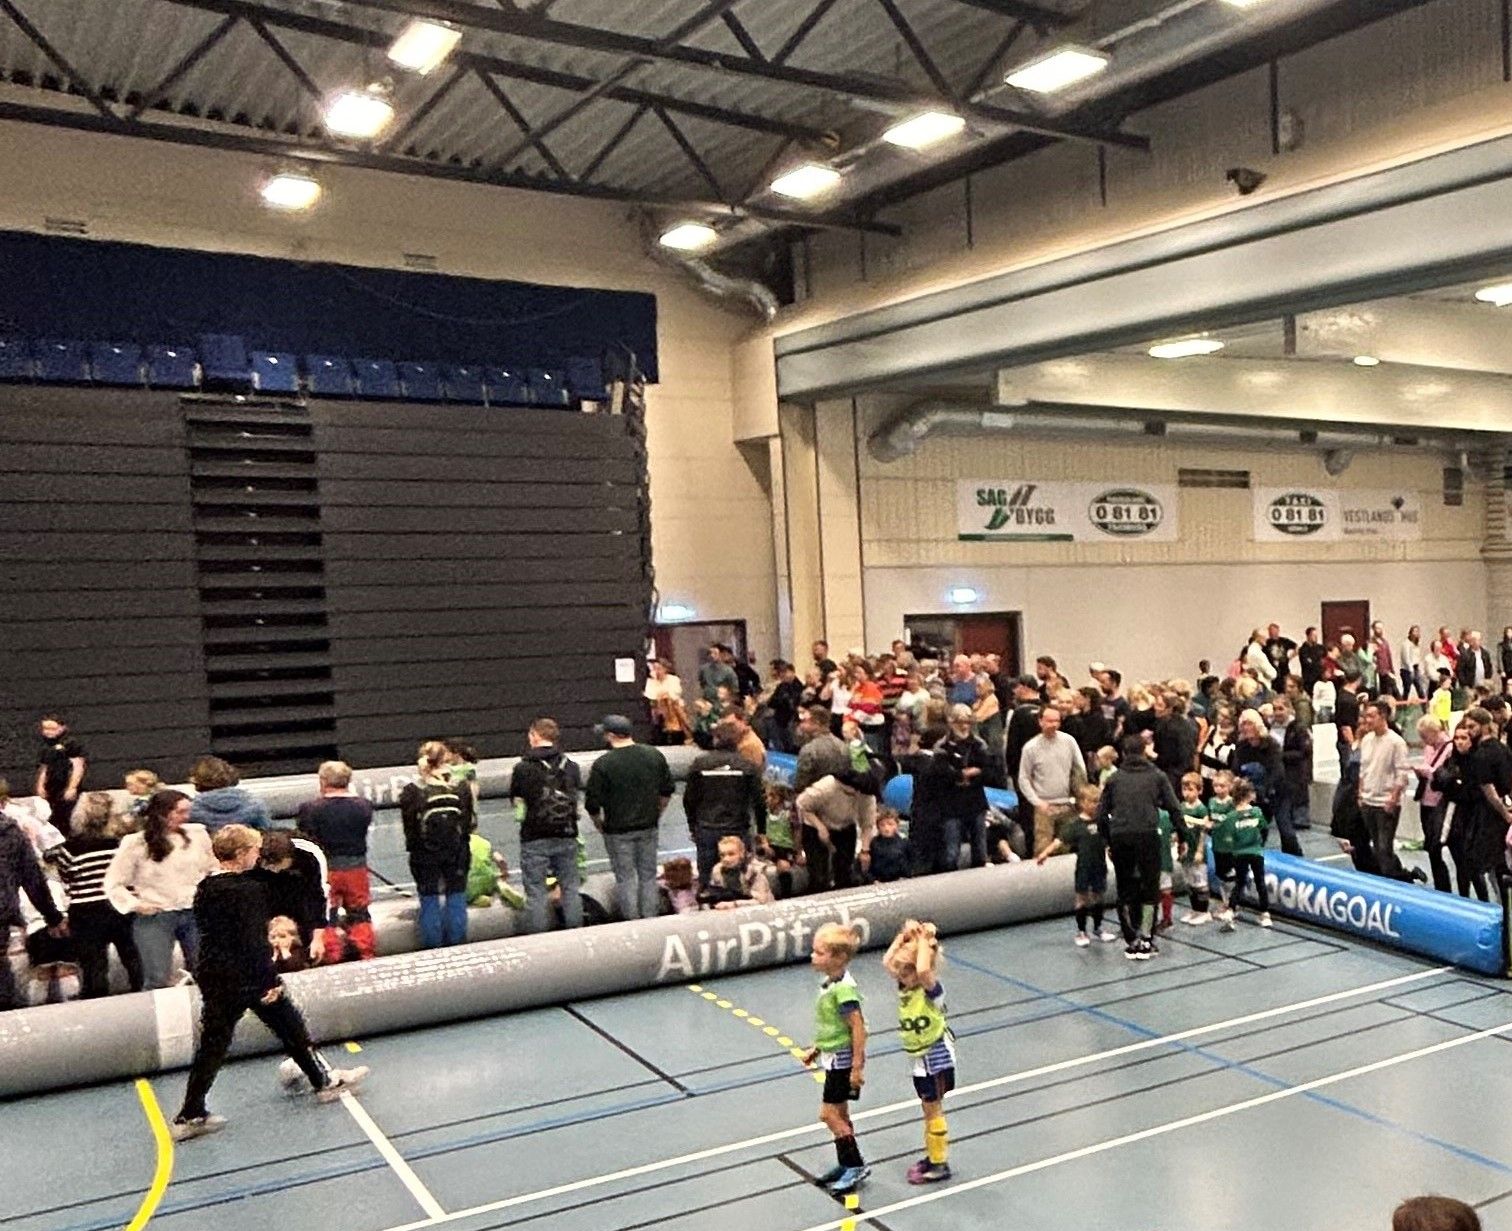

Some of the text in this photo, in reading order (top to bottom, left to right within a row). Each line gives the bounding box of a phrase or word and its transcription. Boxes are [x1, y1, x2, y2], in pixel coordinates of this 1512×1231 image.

[977, 488, 1007, 506] SAG
[1015, 508, 1055, 525] BYGG
[1258, 872, 1400, 938] OOKAGOAL
[656, 904, 871, 982] AirPith
